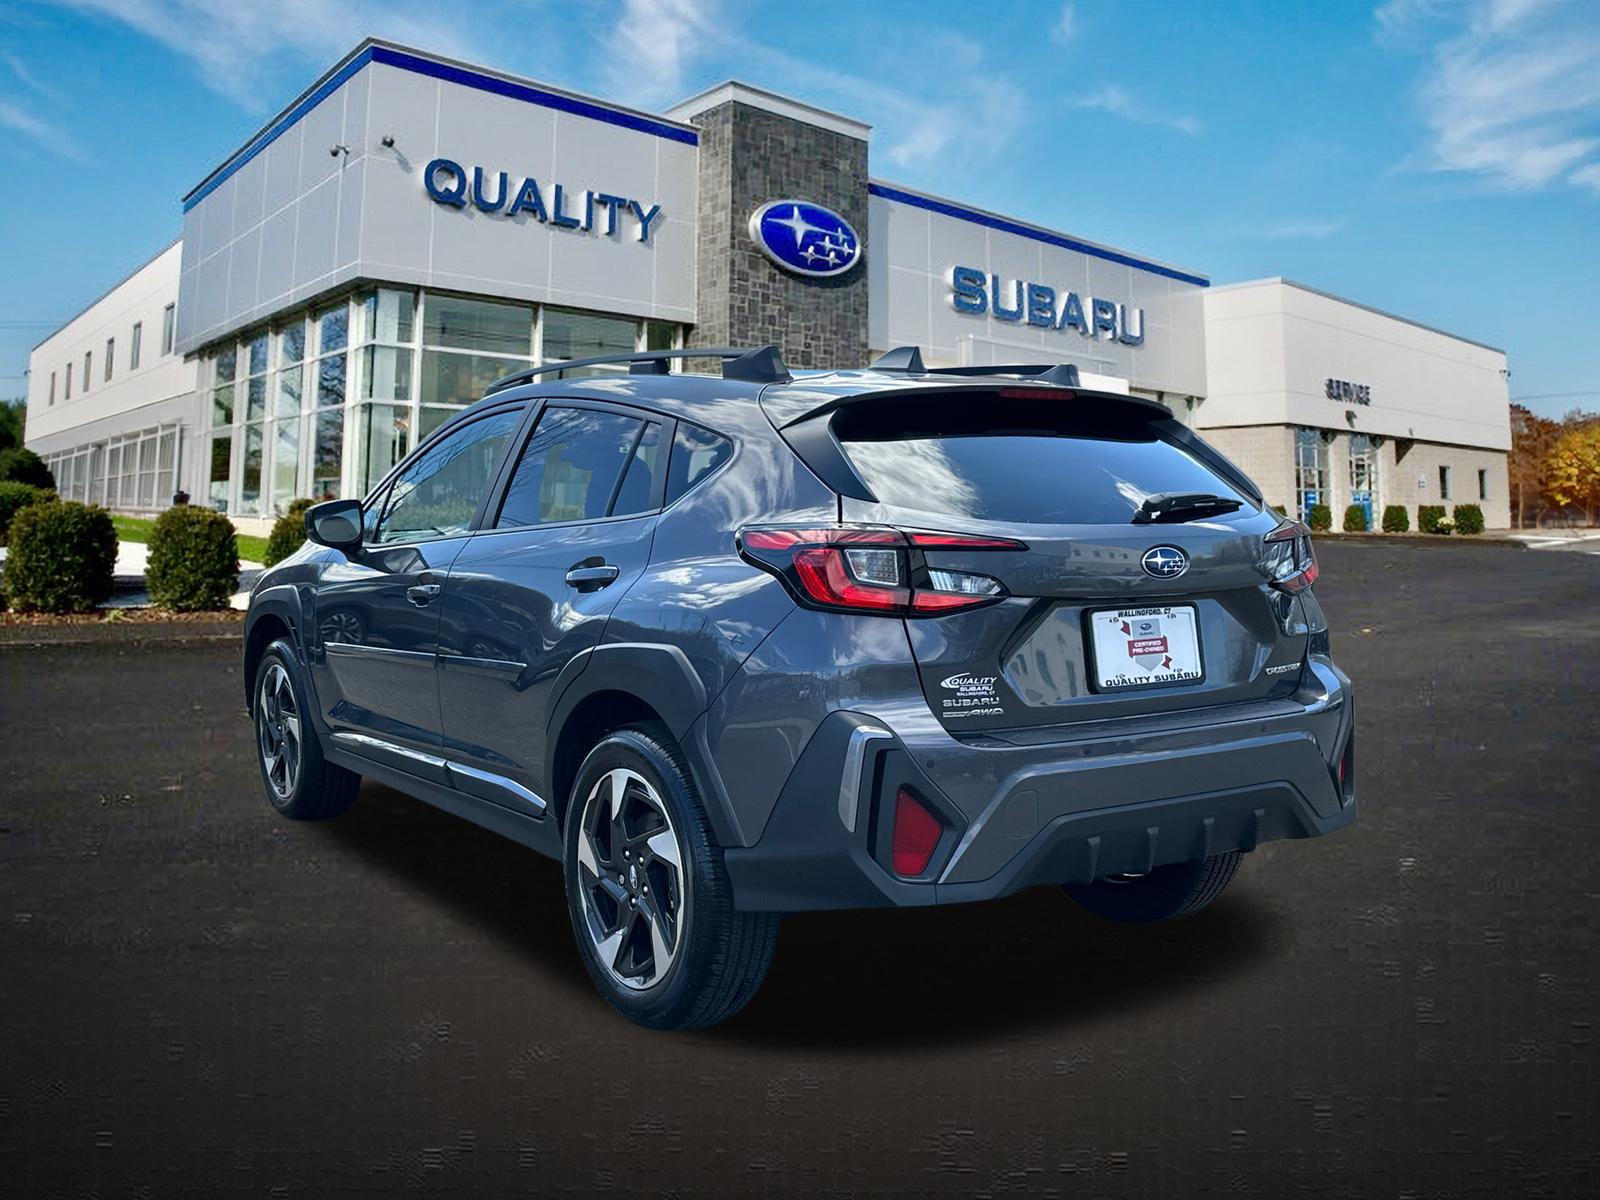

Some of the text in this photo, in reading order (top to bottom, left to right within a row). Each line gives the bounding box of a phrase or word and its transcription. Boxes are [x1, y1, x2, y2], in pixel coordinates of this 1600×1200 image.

[424, 158, 662, 242] QUALITY
[953, 266, 1144, 346] SUBARU
[1163, 607, 1171, 615] CT
[1134, 640, 1161, 648] CERTIFIED
[1132, 646, 1164, 654] PRE-OWNED
[951, 677, 997, 685] QUALITY
[1105, 671, 1199, 687] QUALITY SUBARU
[943, 697, 1000, 707] SUBARU
[967, 707, 1005, 717] AWD
